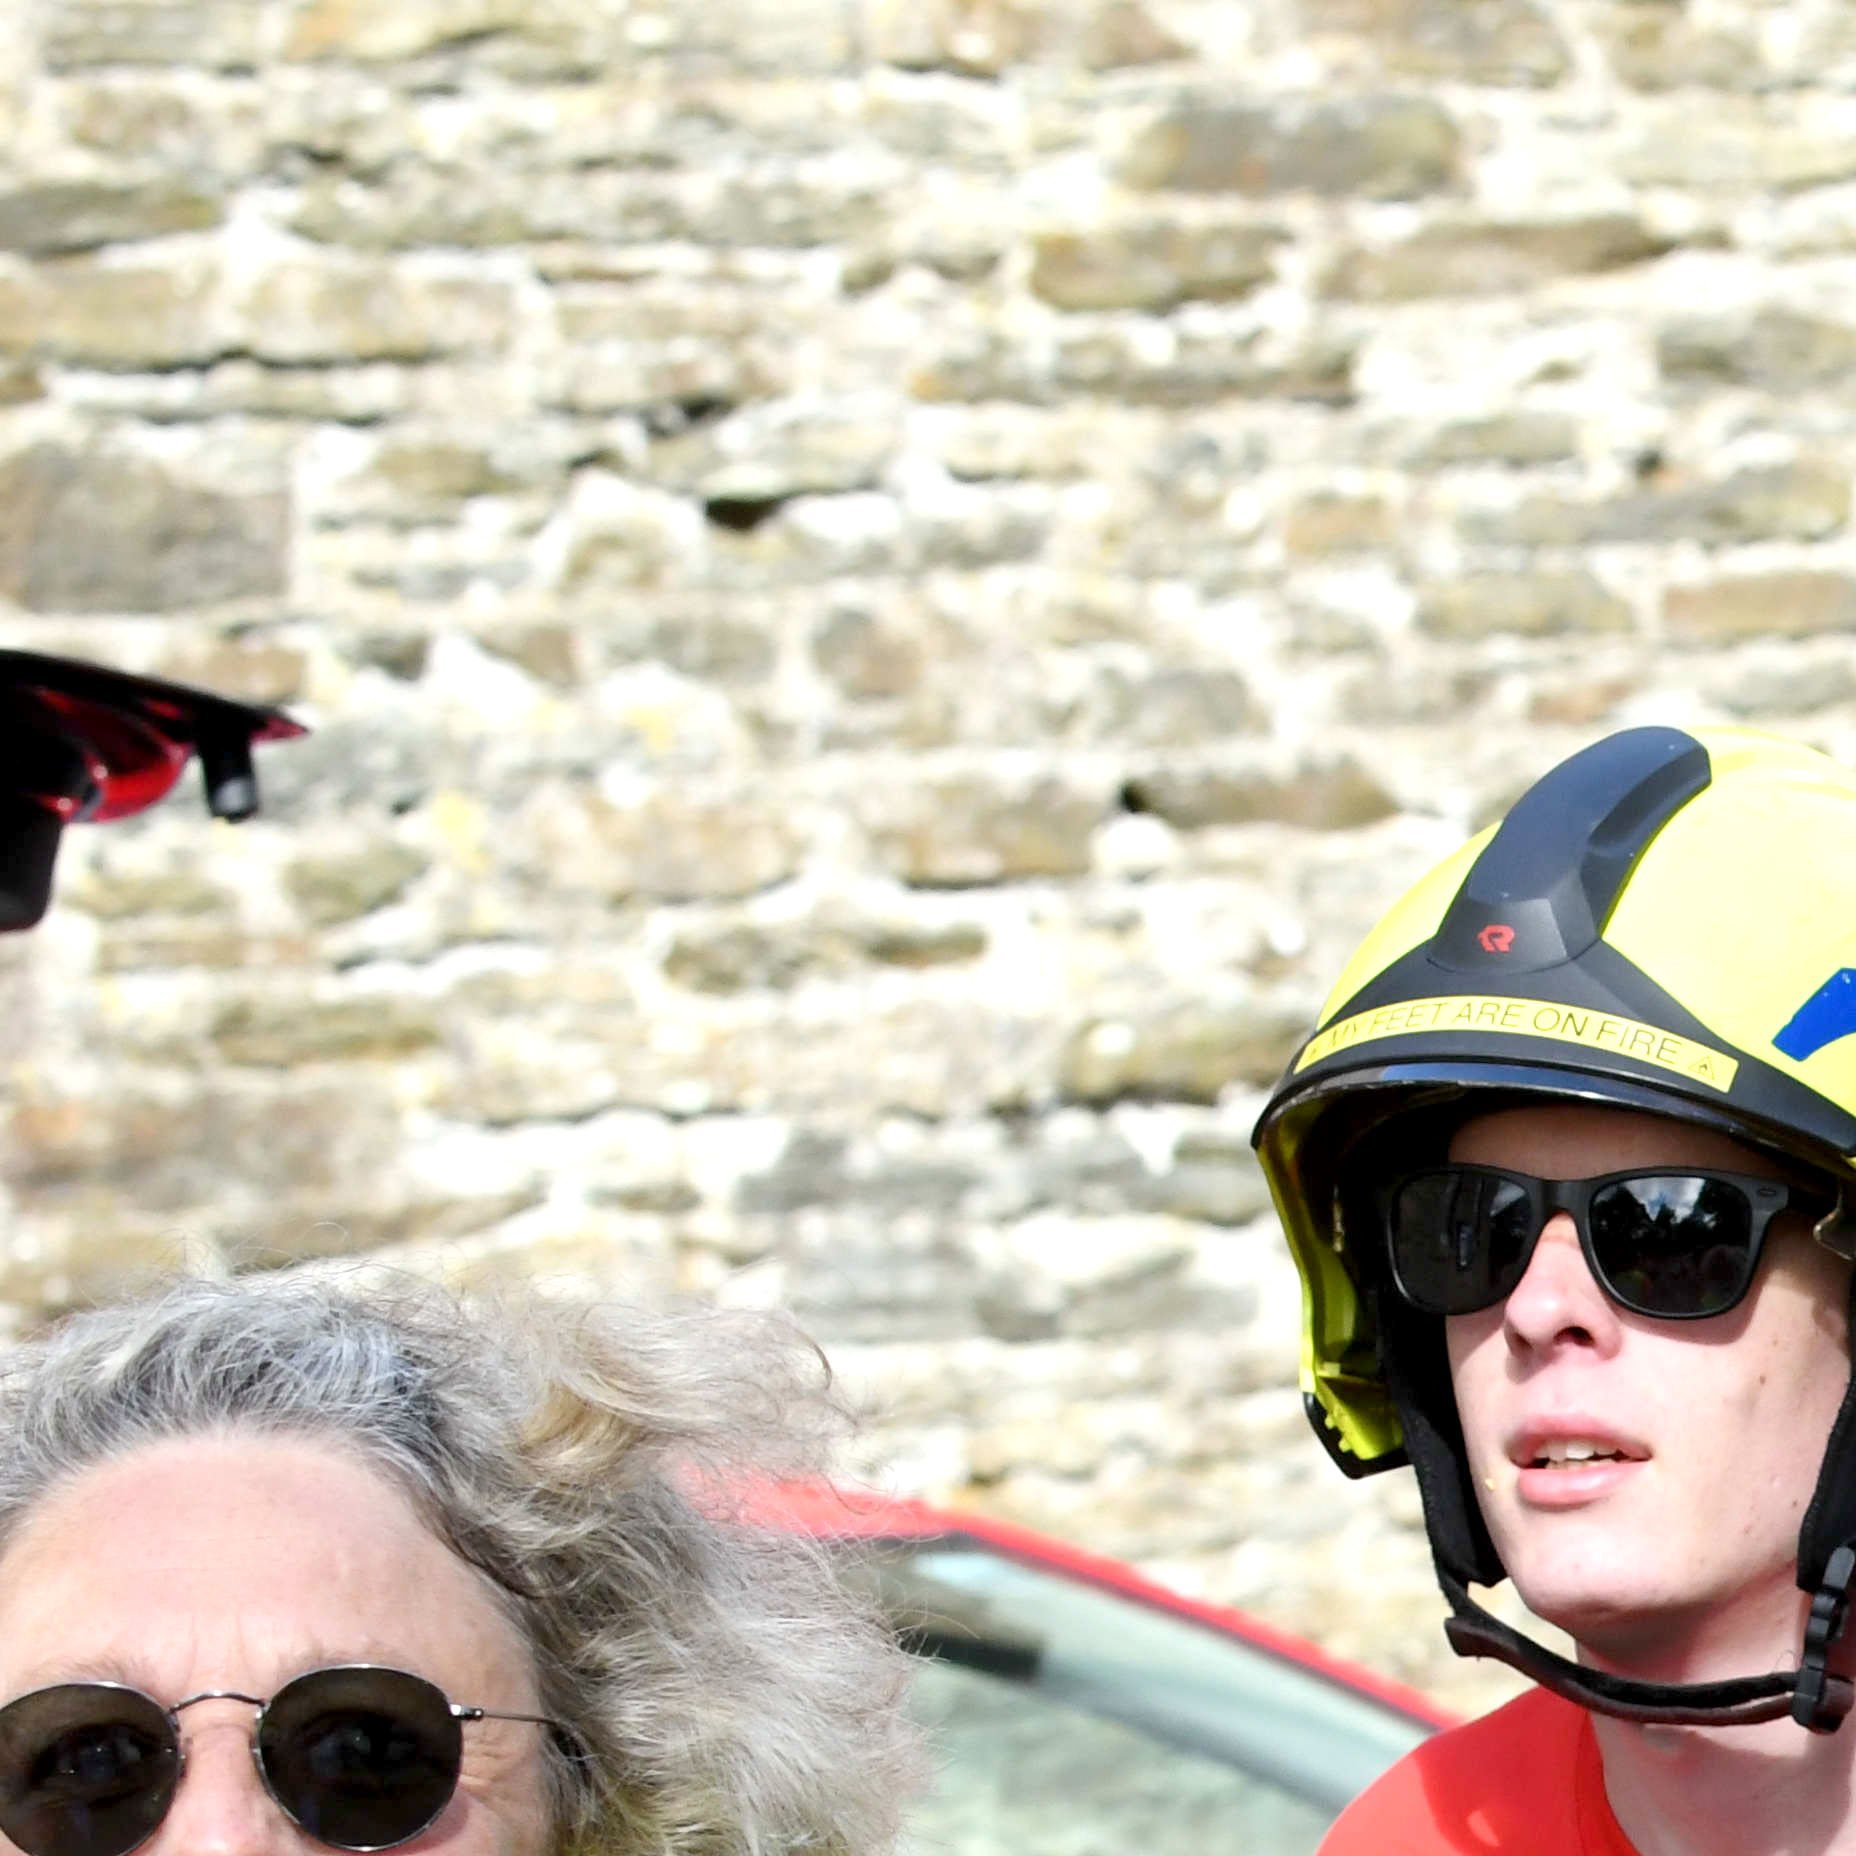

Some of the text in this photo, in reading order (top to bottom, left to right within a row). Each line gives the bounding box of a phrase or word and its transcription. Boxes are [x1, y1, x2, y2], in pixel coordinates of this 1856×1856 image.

[1369, 1003, 1445, 1036] FEET
[1455, 1003, 1521, 1028] ARE
[1533, 1008, 1587, 1037] ON
[1596, 1020, 1682, 1063] FIRE
